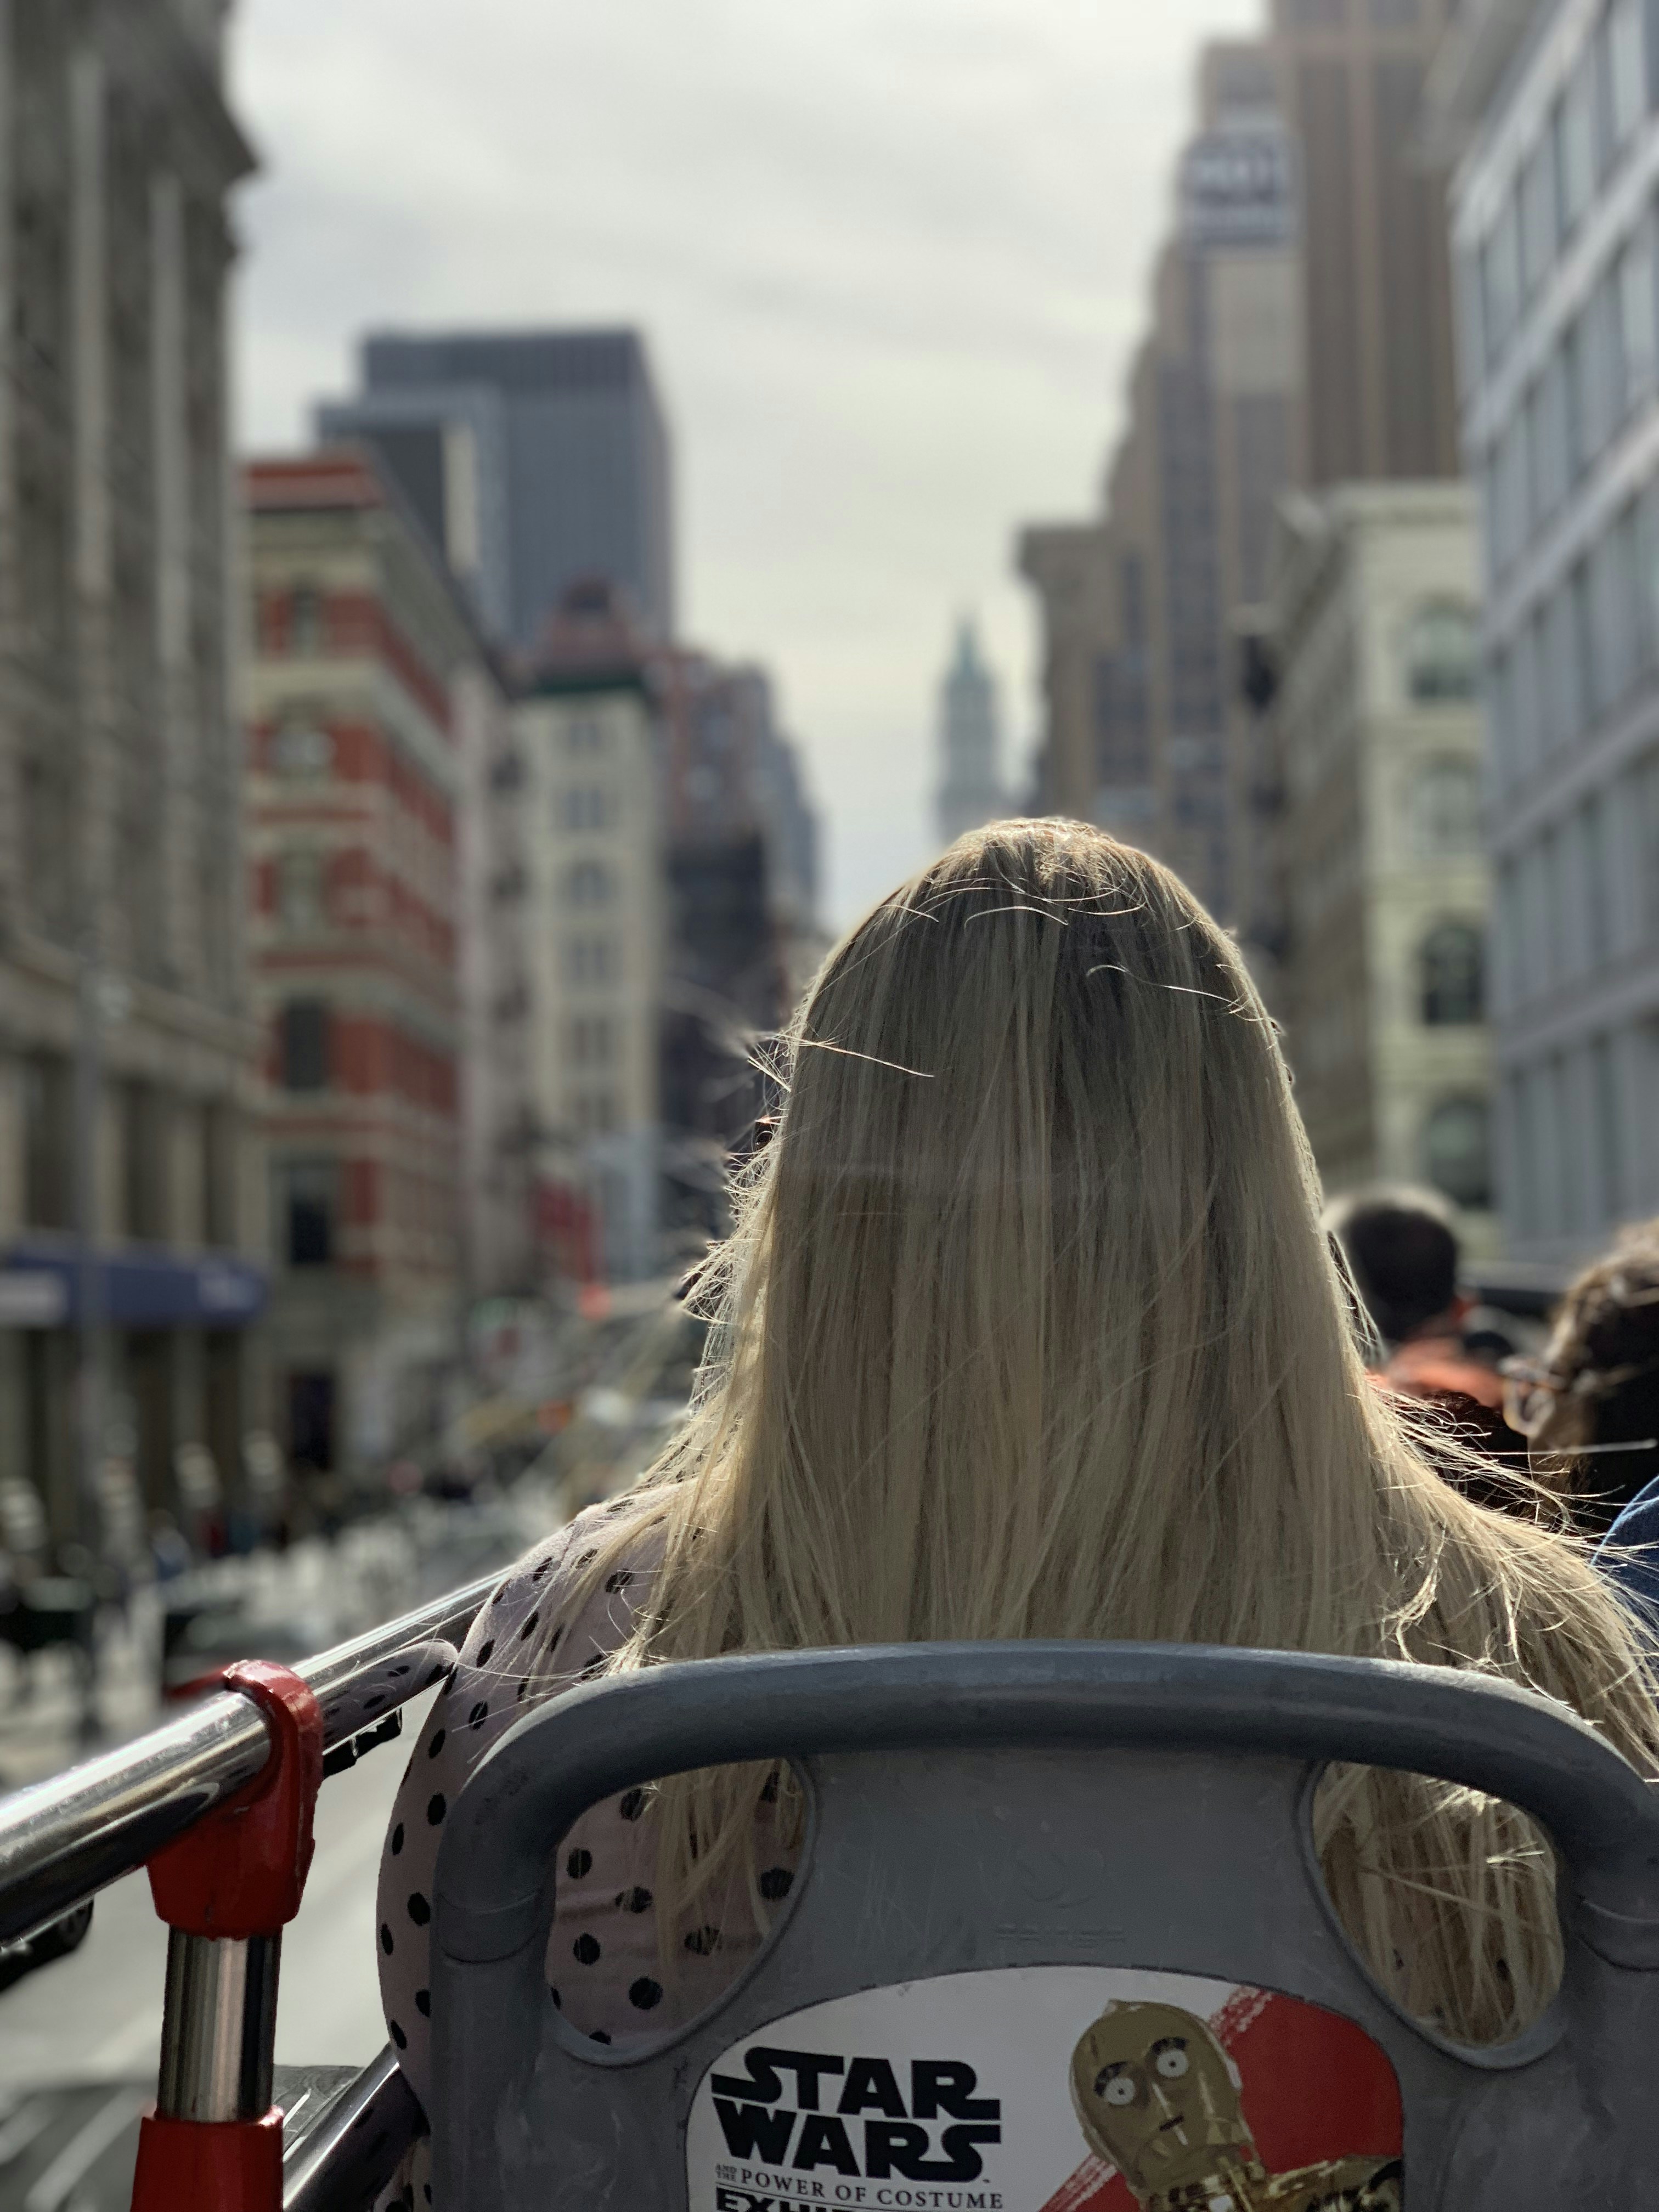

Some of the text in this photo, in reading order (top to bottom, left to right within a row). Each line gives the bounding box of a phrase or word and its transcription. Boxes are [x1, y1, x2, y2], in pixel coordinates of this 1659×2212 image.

[710, 2046, 1001, 2121] STAR
[712, 2096, 1002, 2183] WARS
[741, 2168, 1003, 2209] POWER OF COSTUME
